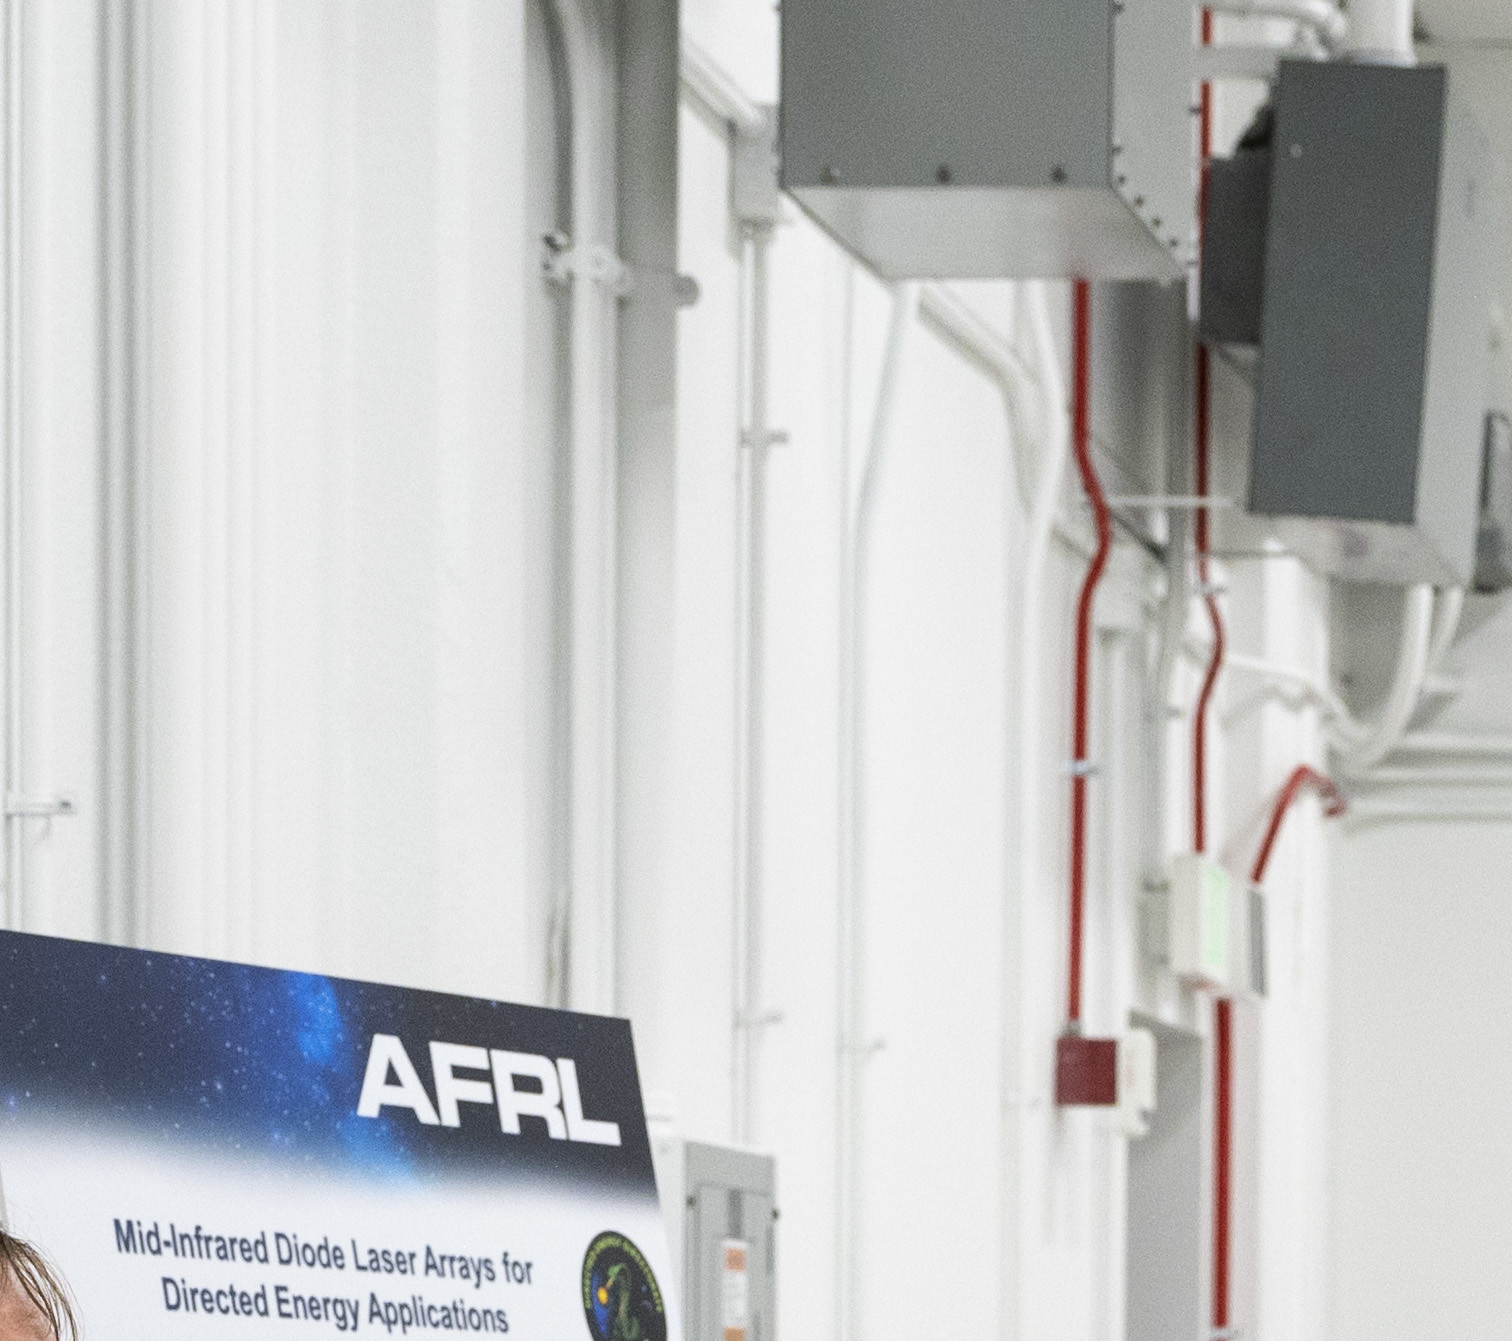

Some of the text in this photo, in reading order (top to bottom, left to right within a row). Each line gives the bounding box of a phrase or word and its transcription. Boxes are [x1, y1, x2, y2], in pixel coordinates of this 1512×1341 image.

[355, 1032, 621, 1147] AFRL
[113, 1217, 534, 1290] Mid-Infrared Diode Laser Arrays for
[161, 1276, 510, 1335] Directed Energy Applications
